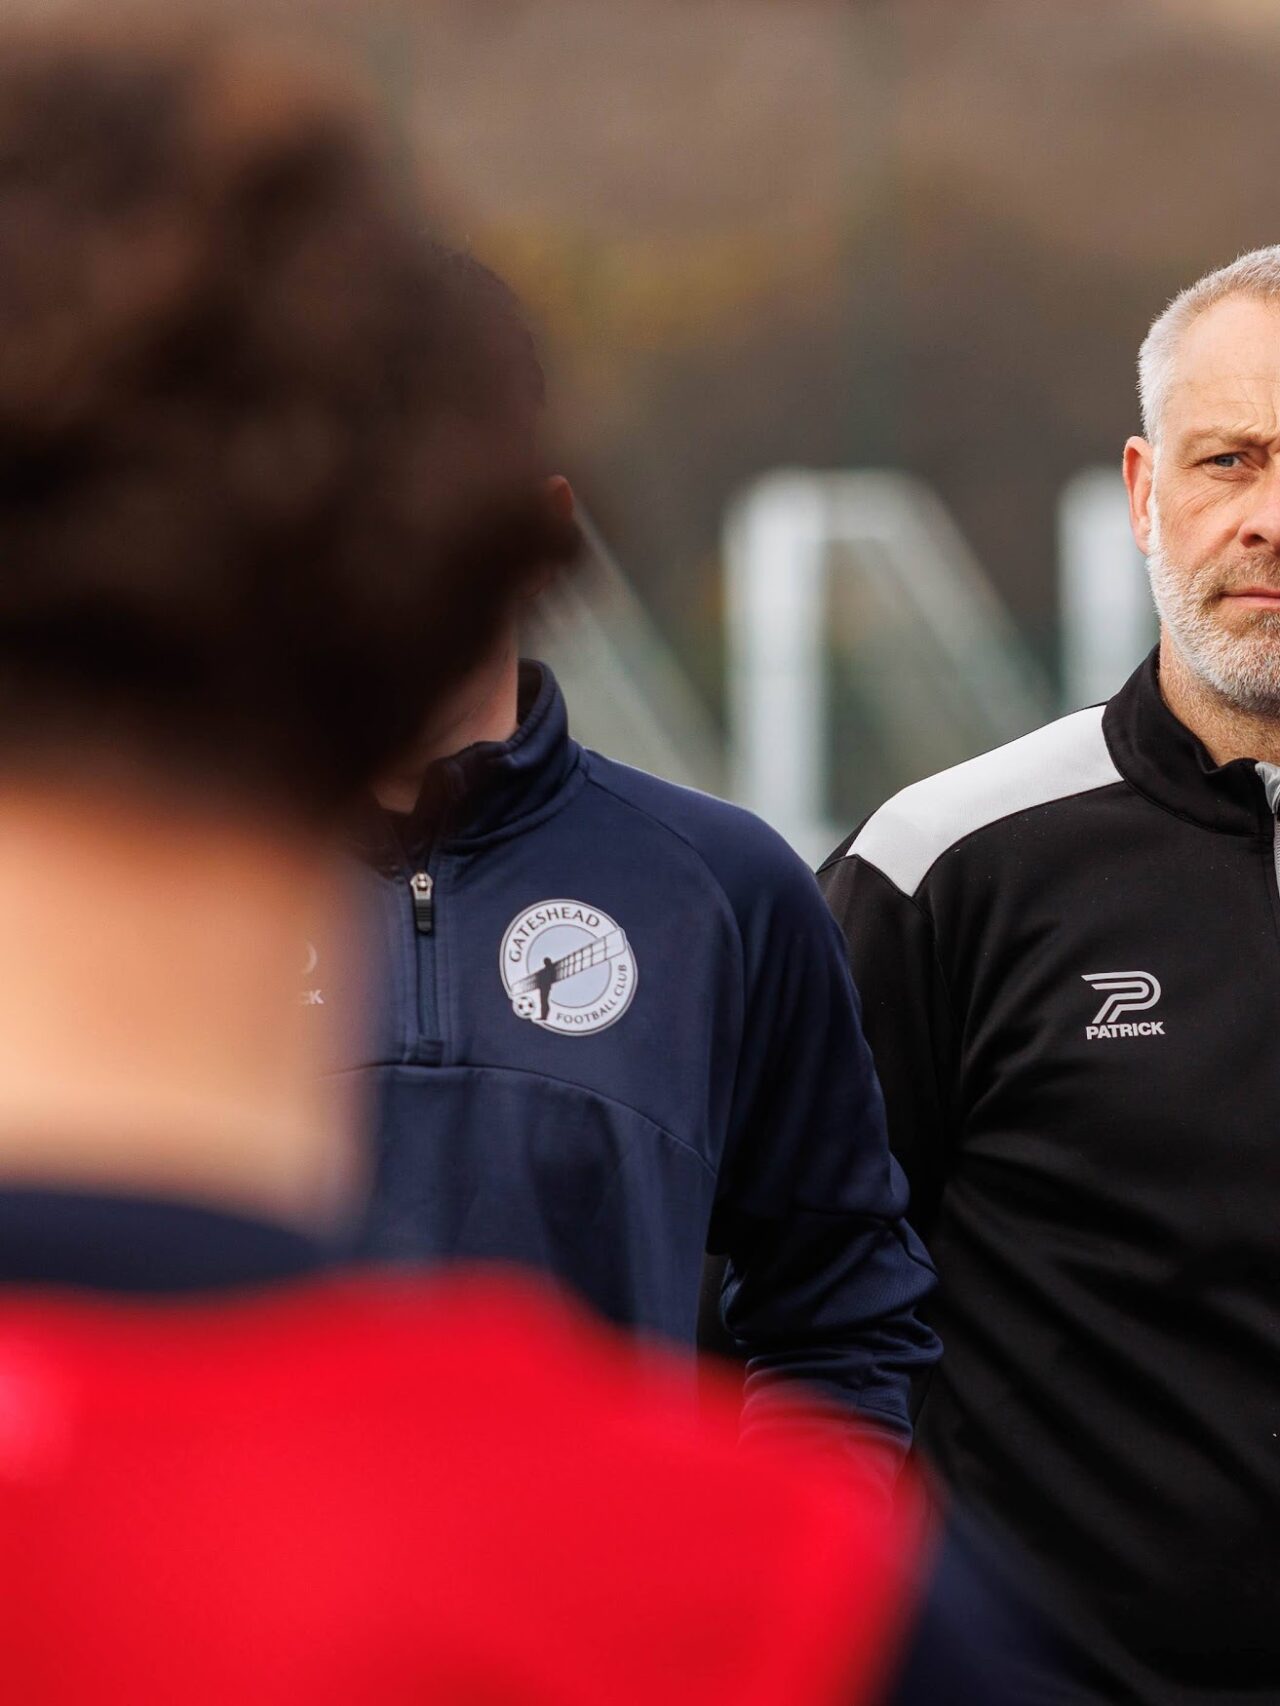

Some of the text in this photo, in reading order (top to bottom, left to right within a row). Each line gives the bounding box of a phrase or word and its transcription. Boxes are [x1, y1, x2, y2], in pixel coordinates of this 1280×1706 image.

[509, 906, 600, 962] GATESHEAD
[556, 964, 627, 1025] FOOTBALL CLUB
[1085, 1021, 1165, 1040] PATRICK
